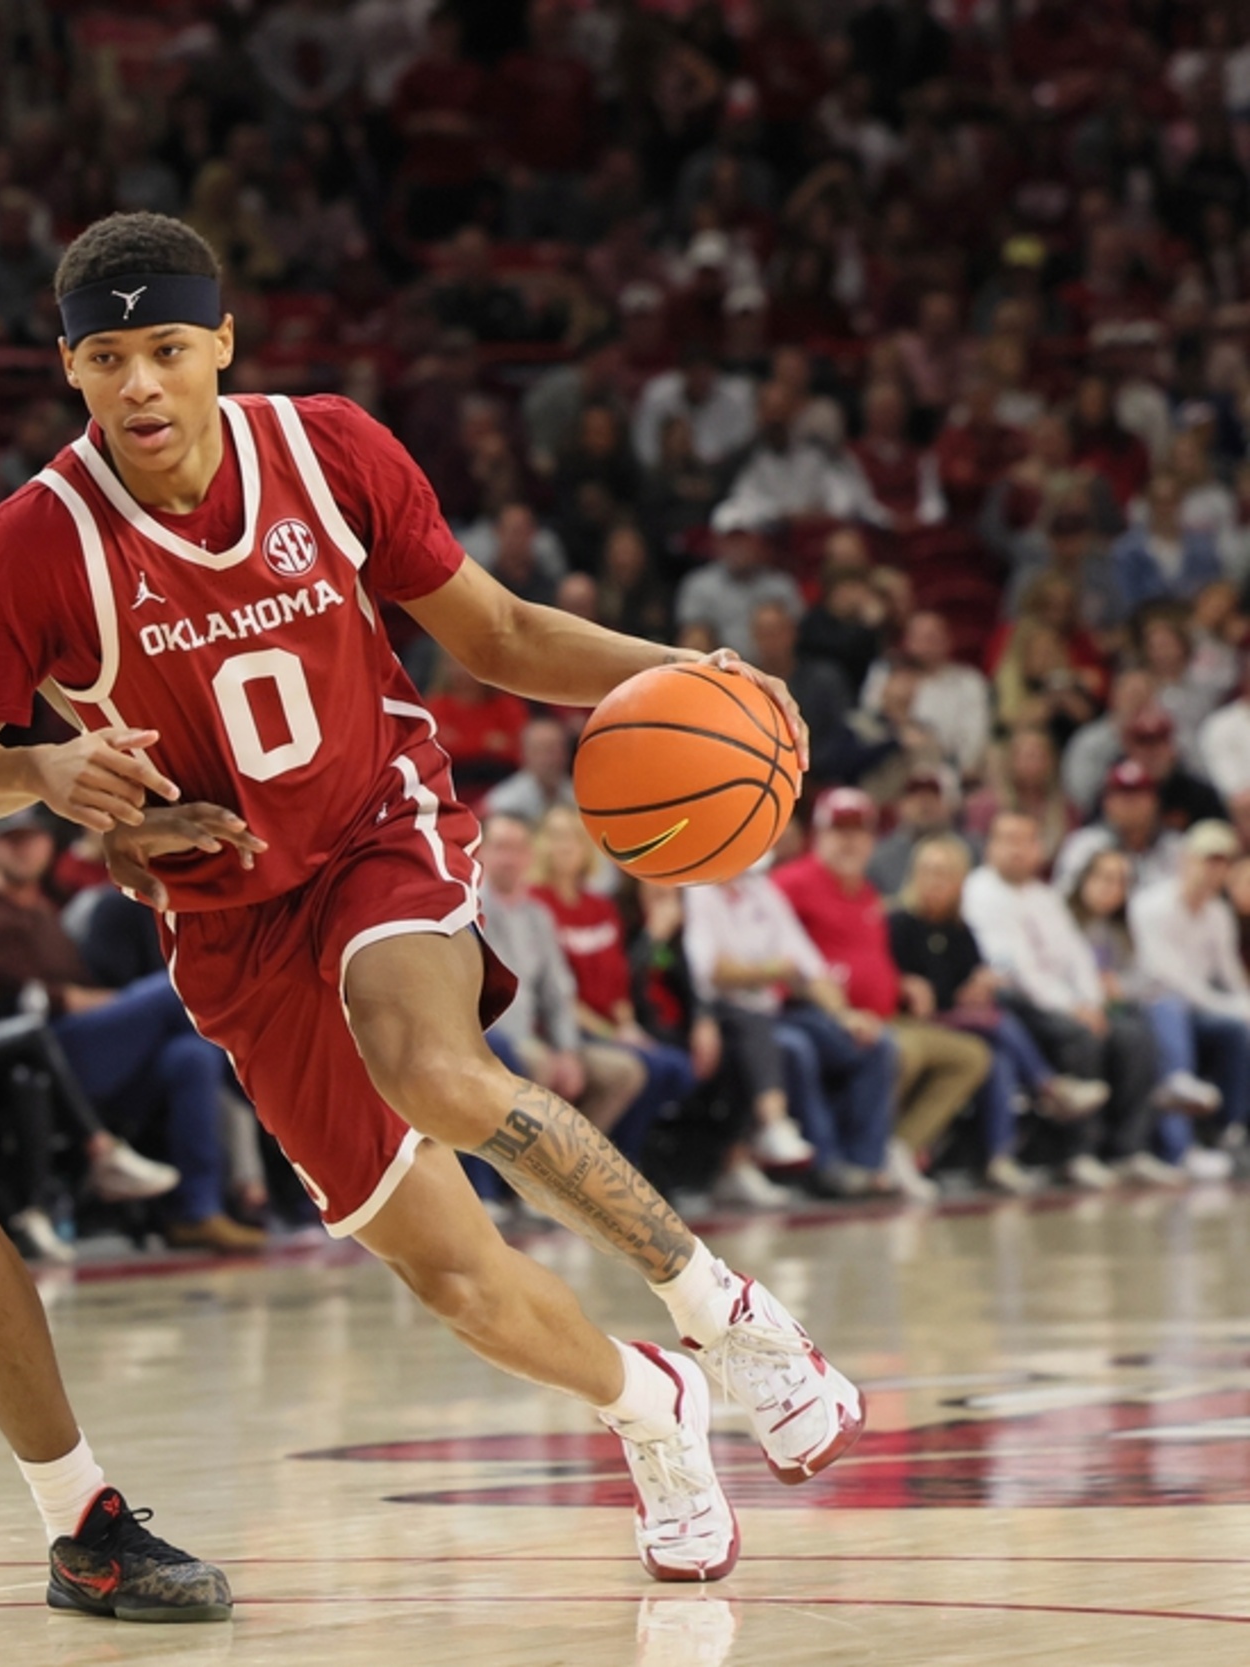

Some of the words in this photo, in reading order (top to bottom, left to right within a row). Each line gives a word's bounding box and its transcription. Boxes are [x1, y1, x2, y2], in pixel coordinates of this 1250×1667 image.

[269, 522, 313, 572] SEC
[139, 579, 344, 656] OKLAHOMA
[212, 647, 322, 782] 0
